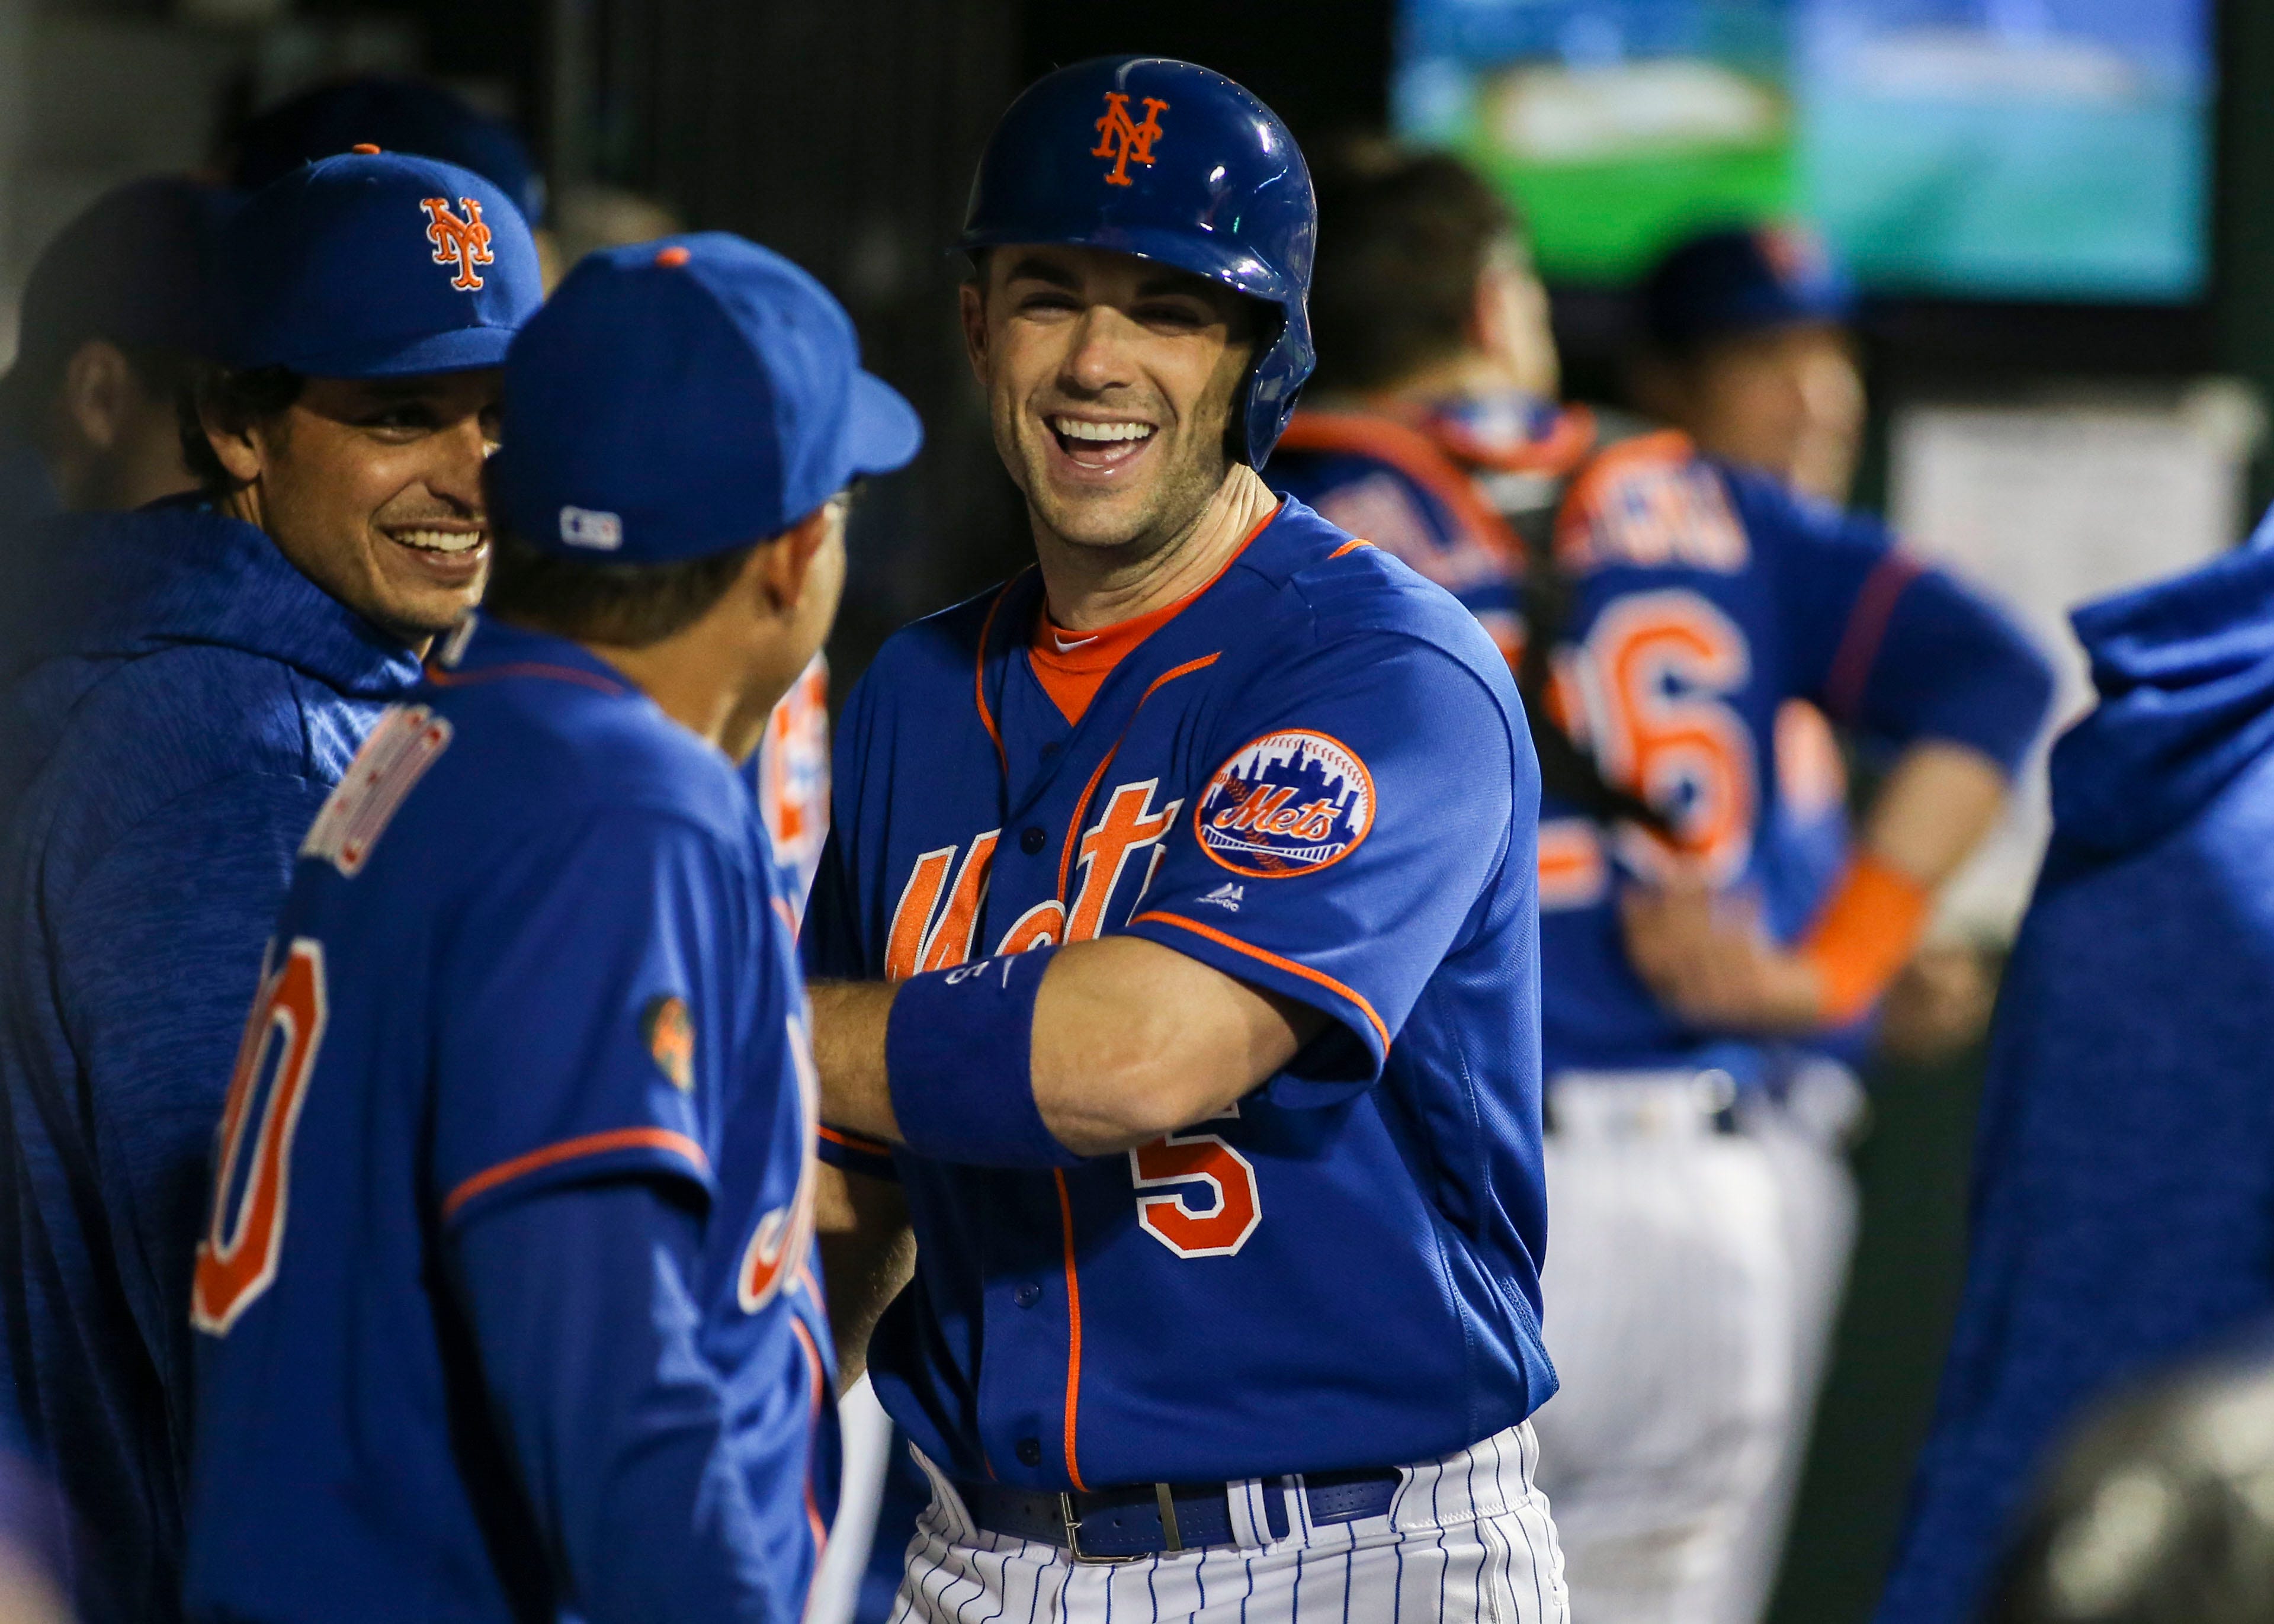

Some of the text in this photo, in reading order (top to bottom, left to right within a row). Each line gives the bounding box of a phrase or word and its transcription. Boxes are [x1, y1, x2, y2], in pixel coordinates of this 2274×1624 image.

[1092, 92, 1170, 185] NY
[419, 197, 494, 291] NY
[1213, 784, 1342, 842] Mets
[1127, 1102, 1262, 1259] 5
